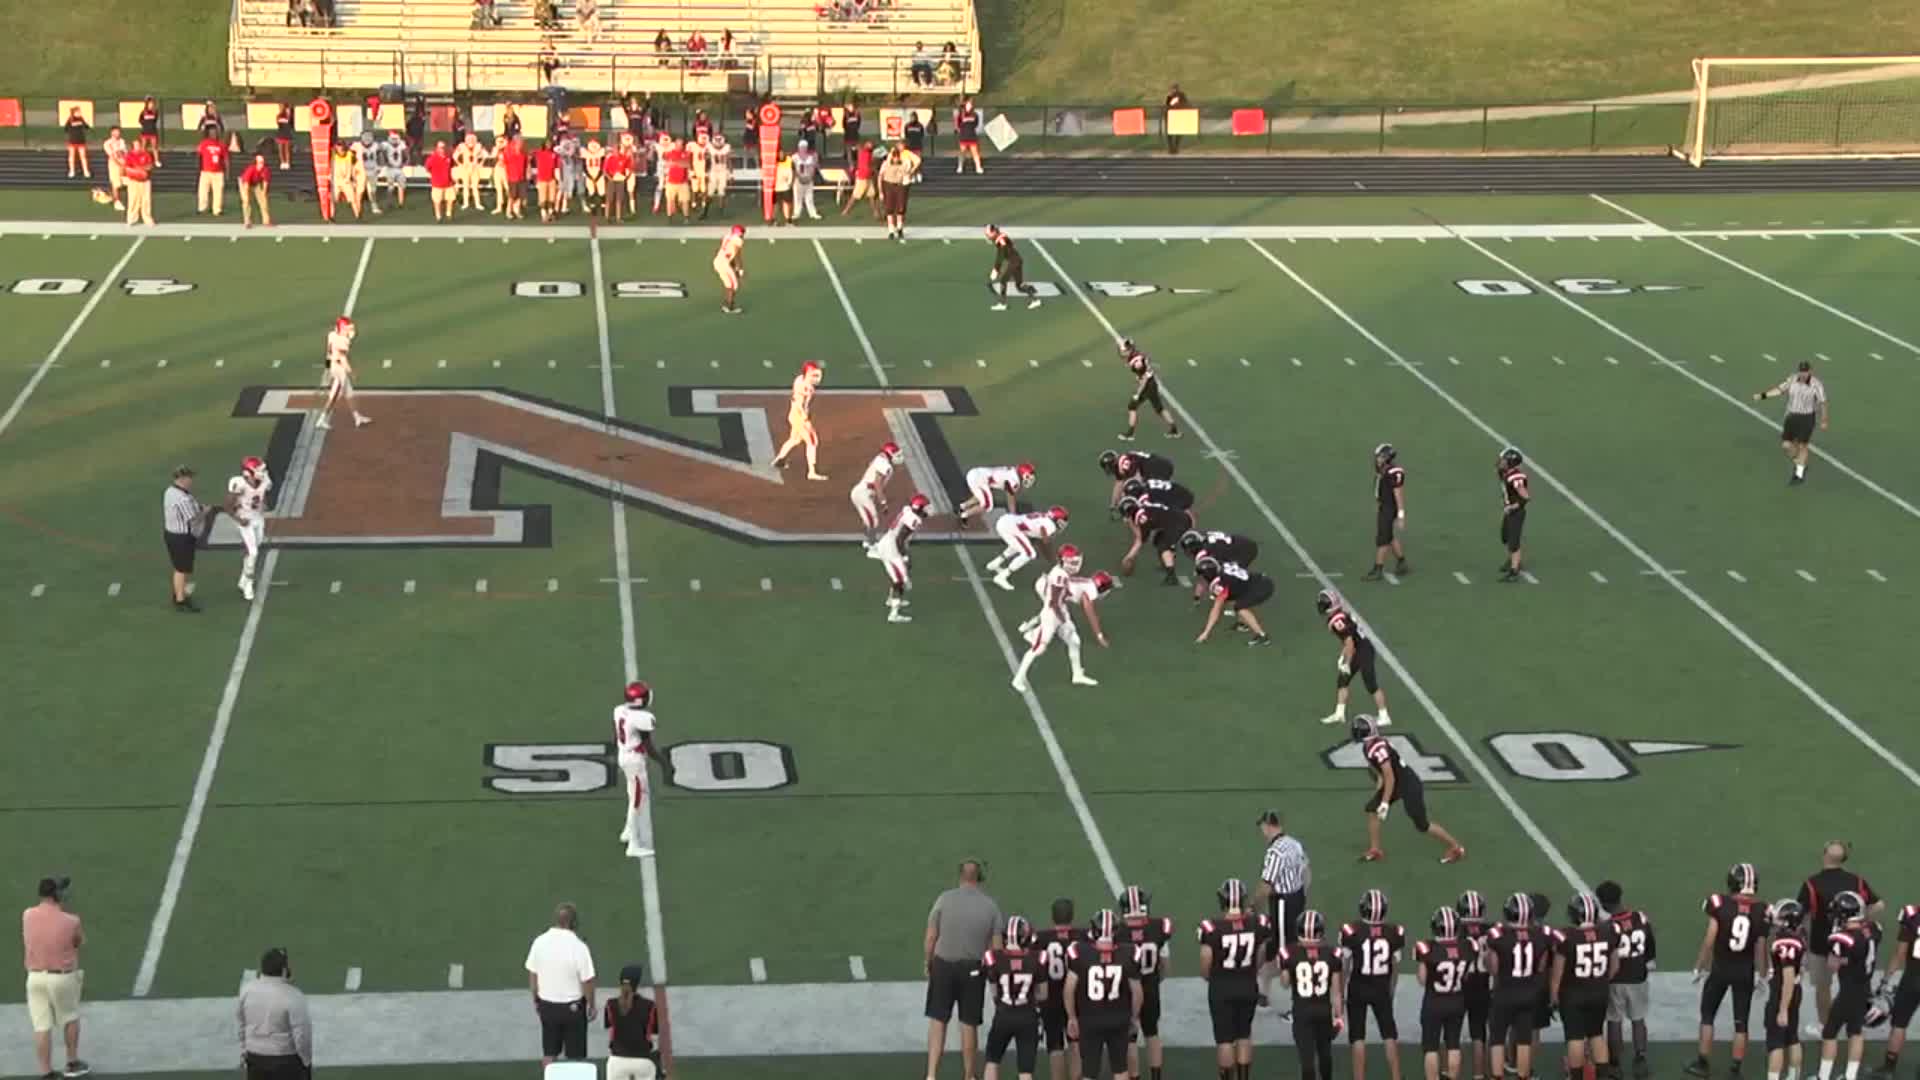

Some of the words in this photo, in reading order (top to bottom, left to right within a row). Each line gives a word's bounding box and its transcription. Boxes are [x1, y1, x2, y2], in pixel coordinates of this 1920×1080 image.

[484, 741, 796, 793] 50
[1322, 733, 1638, 782] 40
[1222, 932, 1255, 968] 77
[1729, 915, 1750, 952] 9
[1047, 942, 1069, 980] 6
[1361, 938, 1390, 975] 12
[1512, 941, 1533, 977] 11
[1574, 942, 1608, 977] 55
[1000, 973, 1033, 1006] 17
[1087, 965, 1122, 1000] 67
[1295, 961, 1329, 997] 83
[1434, 961, 1466, 993] 31
